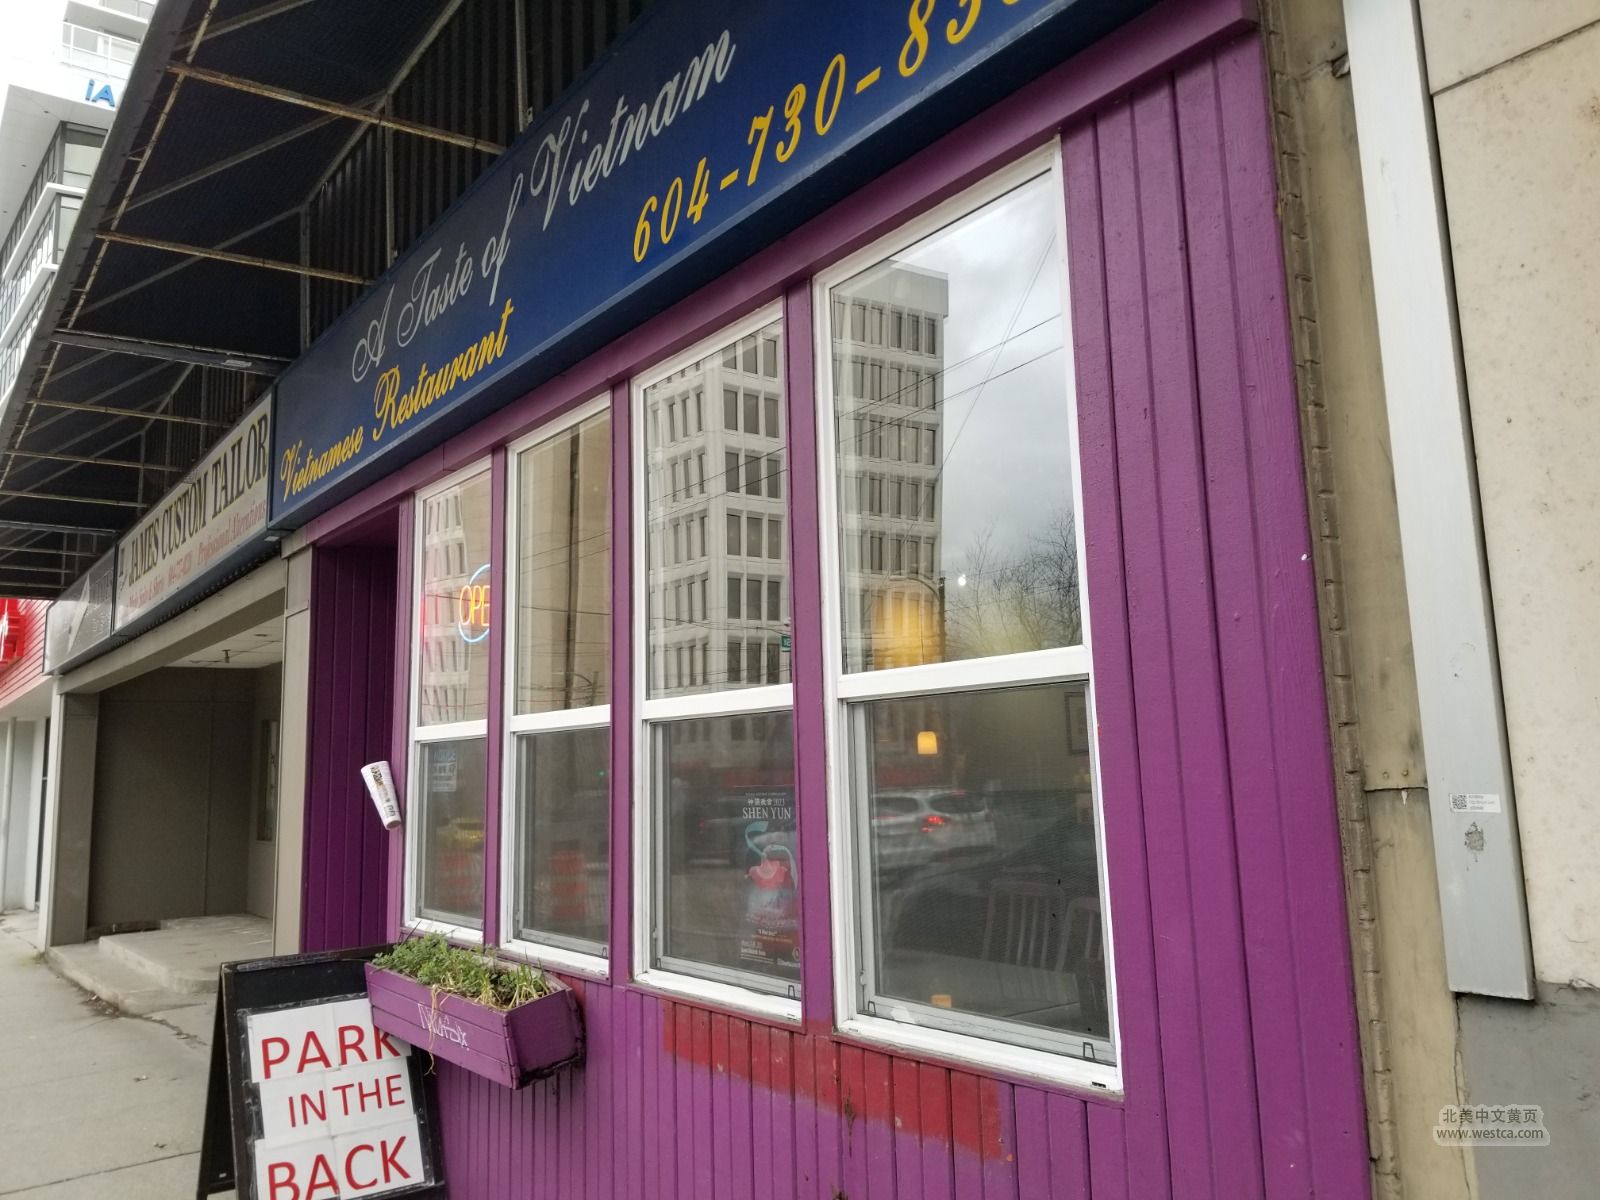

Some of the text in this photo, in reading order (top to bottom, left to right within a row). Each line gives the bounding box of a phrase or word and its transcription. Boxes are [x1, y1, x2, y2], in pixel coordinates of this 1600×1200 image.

[633, 0, 1021, 263] 604-730-83
[352, 29, 737, 382] A Taste of Vietnam
[280, 299, 514, 502] Vietnamese Restaurant
[128, 413, 269, 588] JAMES CUSTOM TAILOR
[742, 807, 792, 820] SHEN YUN
[261, 1024, 401, 1080] PARK
[288, 1074, 406, 1128] IN THE
[268, 1136, 411, 1200] BACK
